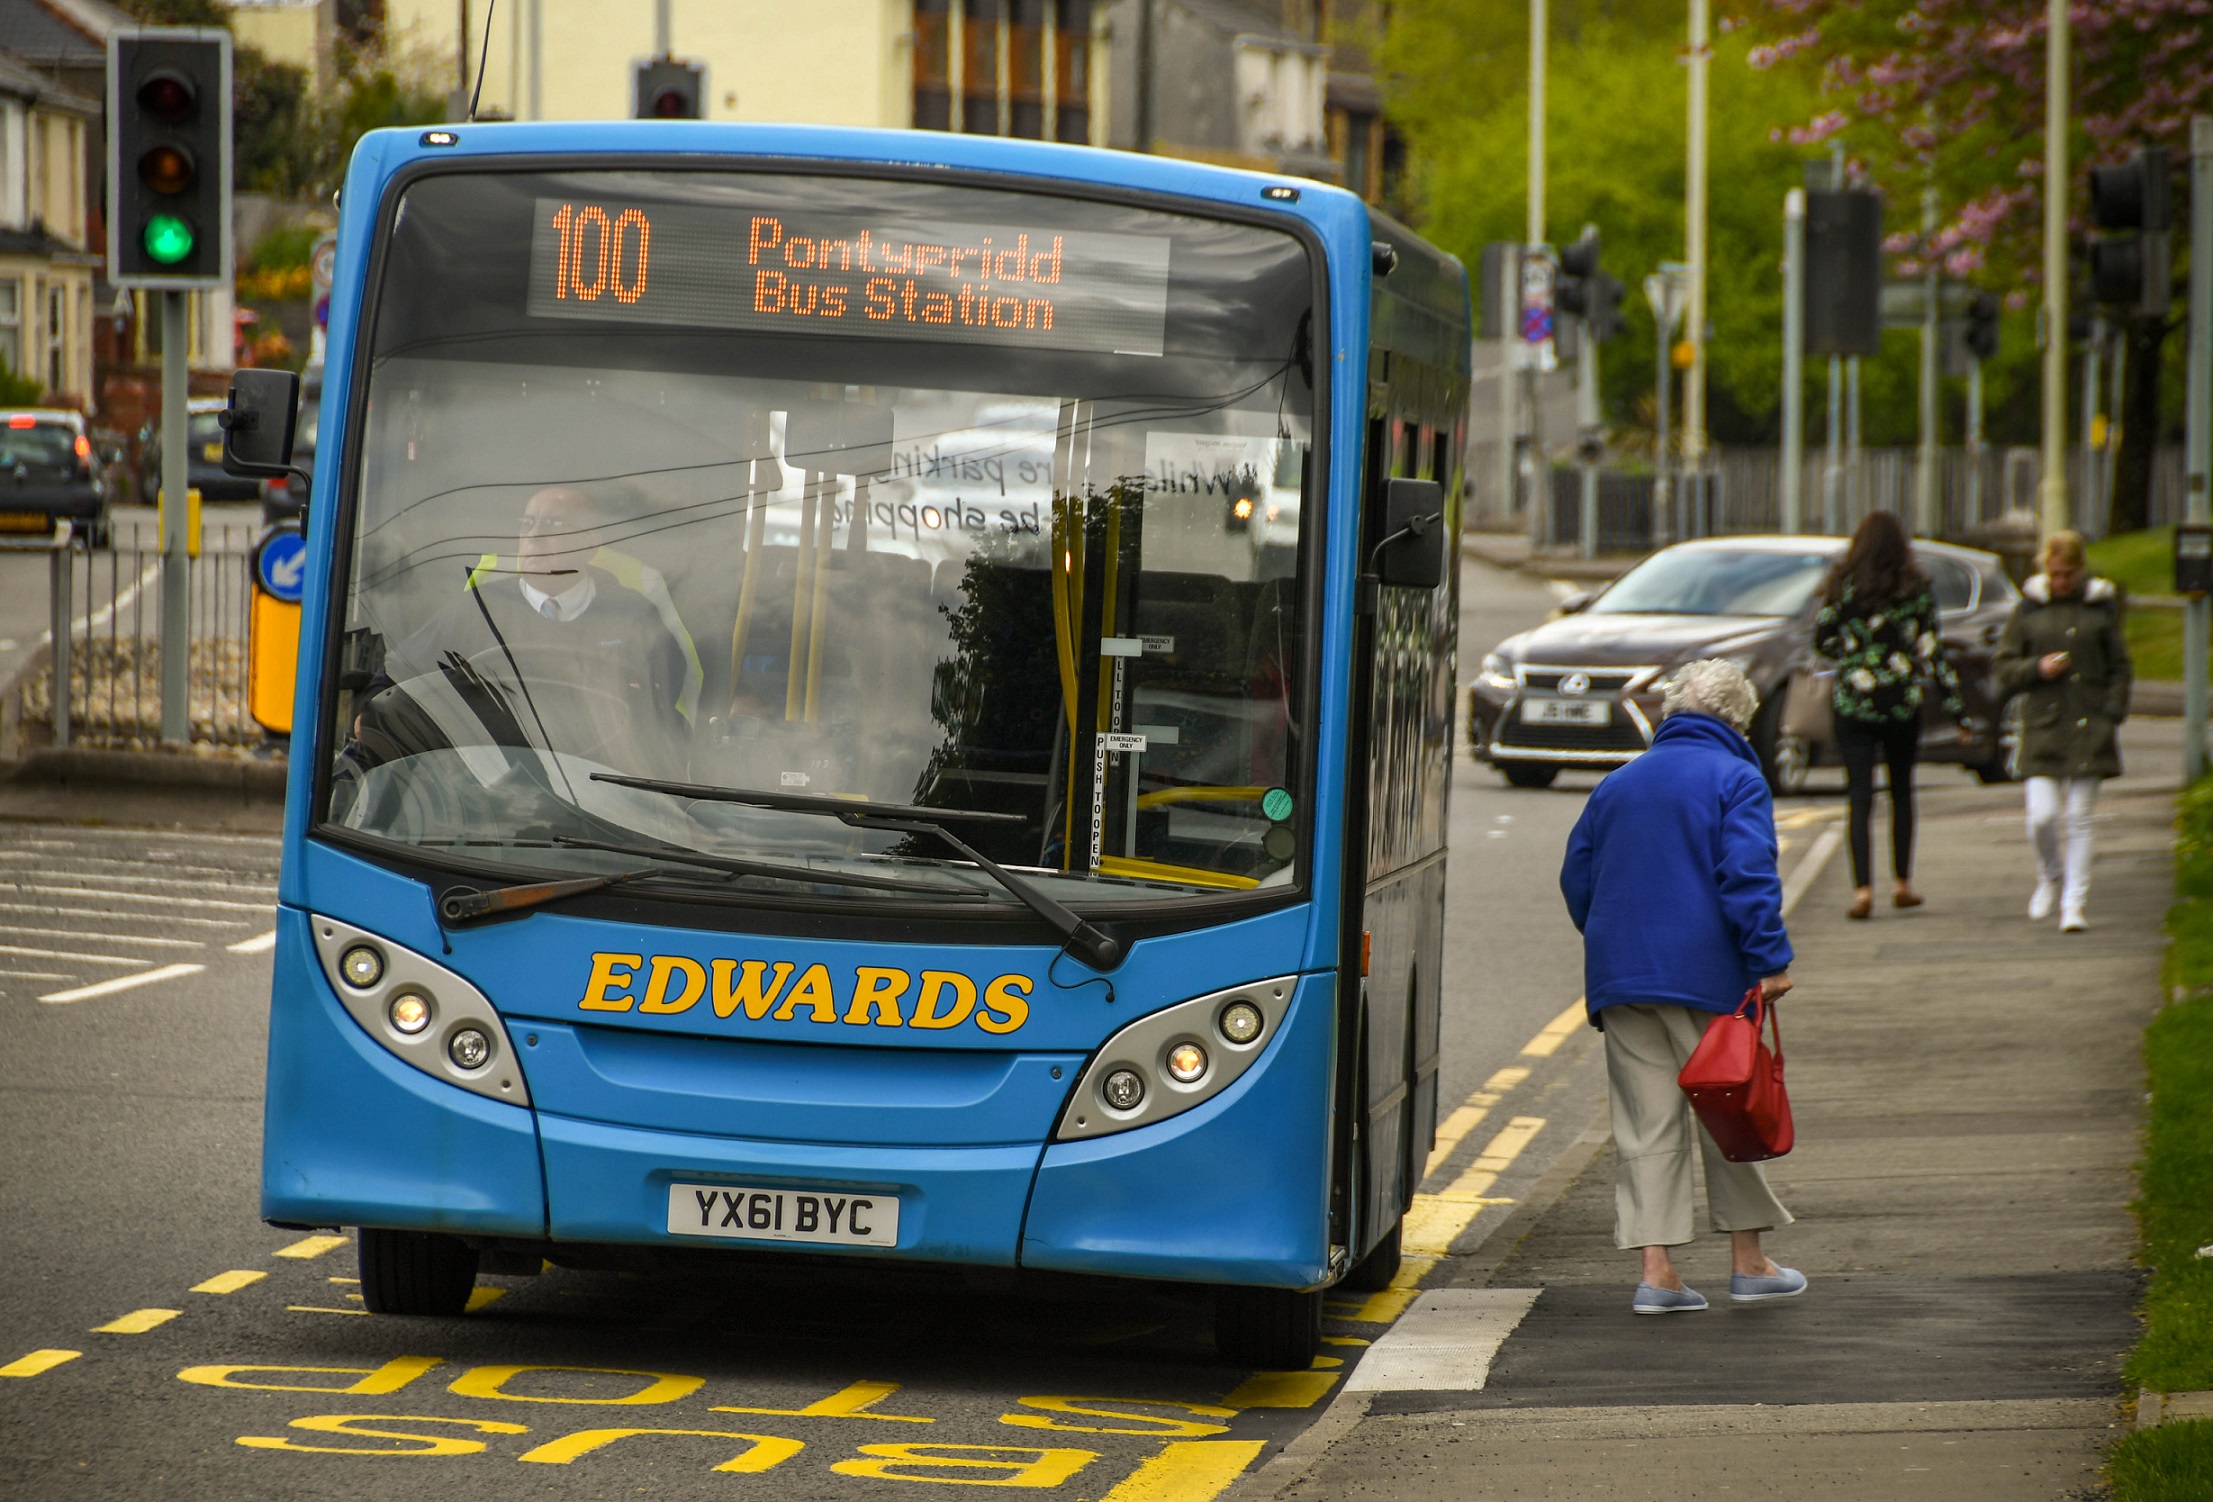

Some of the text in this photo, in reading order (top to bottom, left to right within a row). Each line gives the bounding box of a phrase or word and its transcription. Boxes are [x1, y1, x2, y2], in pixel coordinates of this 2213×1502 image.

[551, 203, 650, 303] 100
[749, 216, 1064, 284] Pontypridd
[753, 270, 1054, 330] Bus Station
[1091, 737, 1104, 866] PUSH TO OPEN
[578, 952, 1034, 1035] EDWARDS
[695, 1191, 873, 1235] YX61 BYC
[177, 1356, 1239, 1437] STOP
[235, 1414, 1103, 1488] BUS
